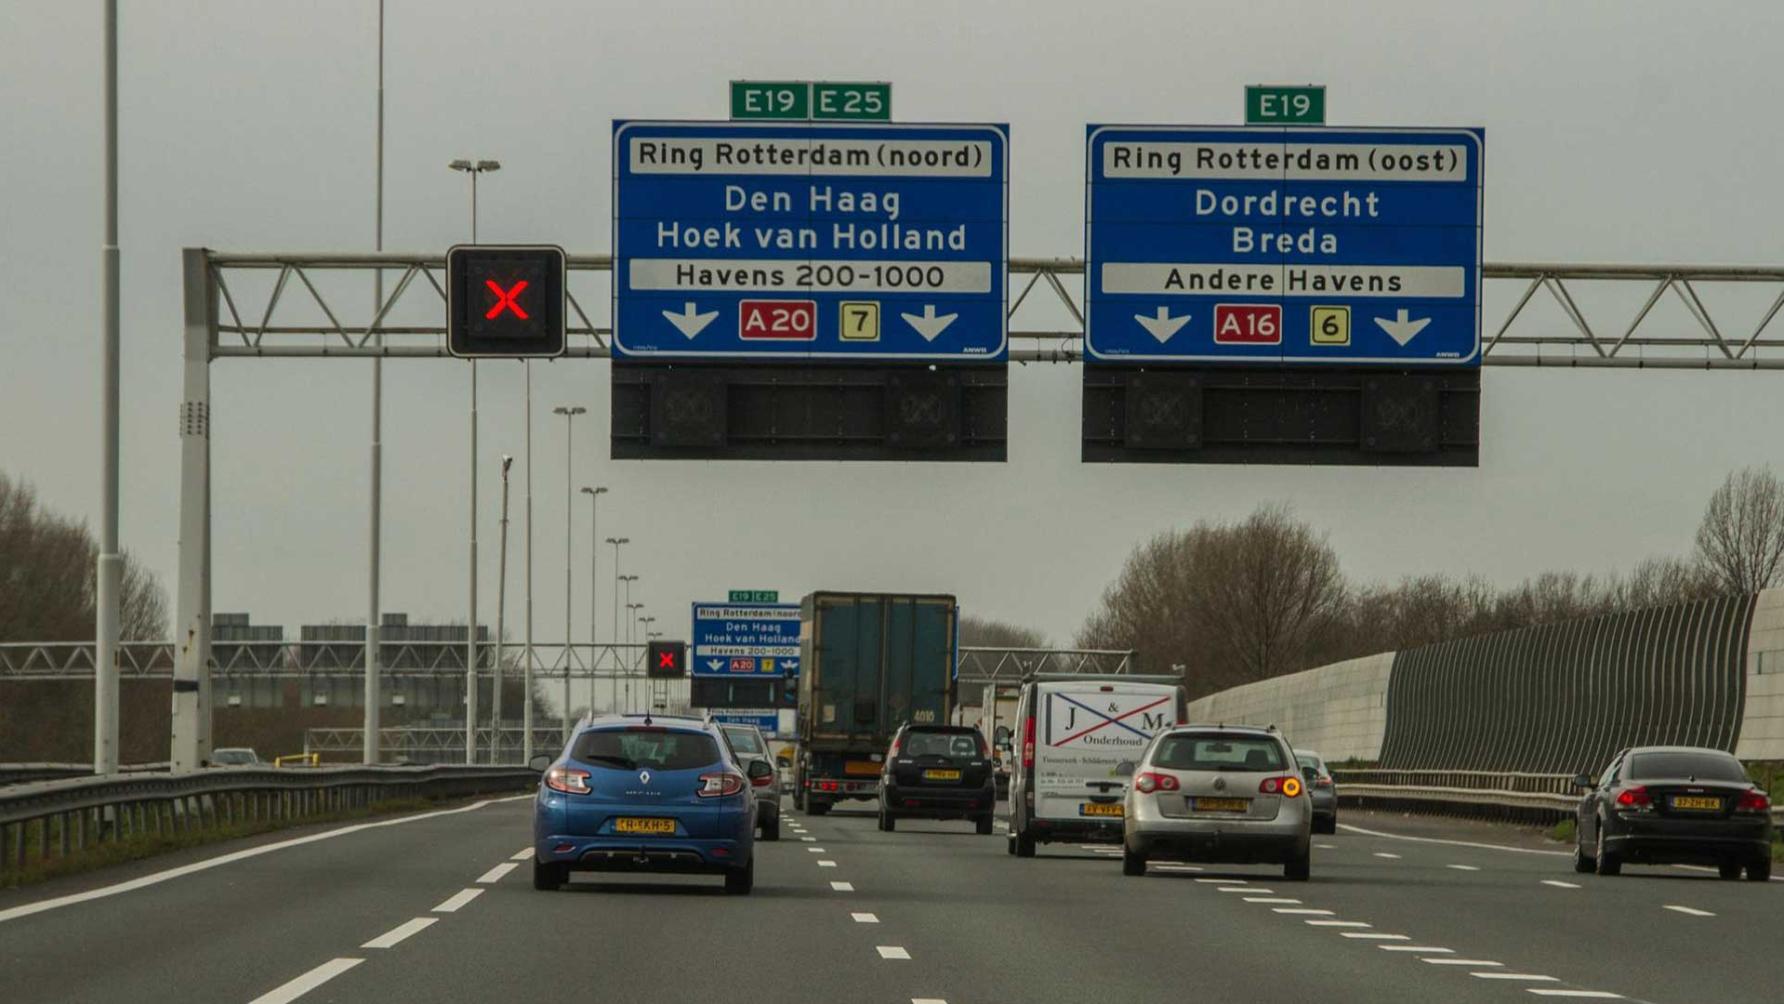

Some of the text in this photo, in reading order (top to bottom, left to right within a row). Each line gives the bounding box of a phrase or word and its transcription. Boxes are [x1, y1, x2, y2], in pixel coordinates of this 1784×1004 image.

[745, 90, 795, 112] E19
[1260, 95, 1311, 117] E19
[639, 142, 983, 170] Ring Rotterdam (noord)
[1114, 147, 1459, 174] Ring Rotterdam (oost)
[726, 185, 901, 220] Den Haag
[1196, 190, 1379, 217] Dordrecht
[658, 222, 966, 250] Hoek van Holland
[1233, 227, 1338, 253] Breda
[676, 264, 944, 287] Havens 200-1000
[1165, 269, 1403, 291] Andere Havens
[851, 310, 868, 332] 7
[1322, 315, 1339, 336] 6
[700, 608, 720, 618] Ring
[723, 609, 771, 617] Rotterdam
[705, 633, 731, 643] Hoek
[726, 622, 781, 633] Den Haag
[710, 647, 745, 655] Havens
[1065, 707, 1076, 730] J
[1108, 702, 1119, 713] &
[1083, 735, 1143, 746] Onderhoud
